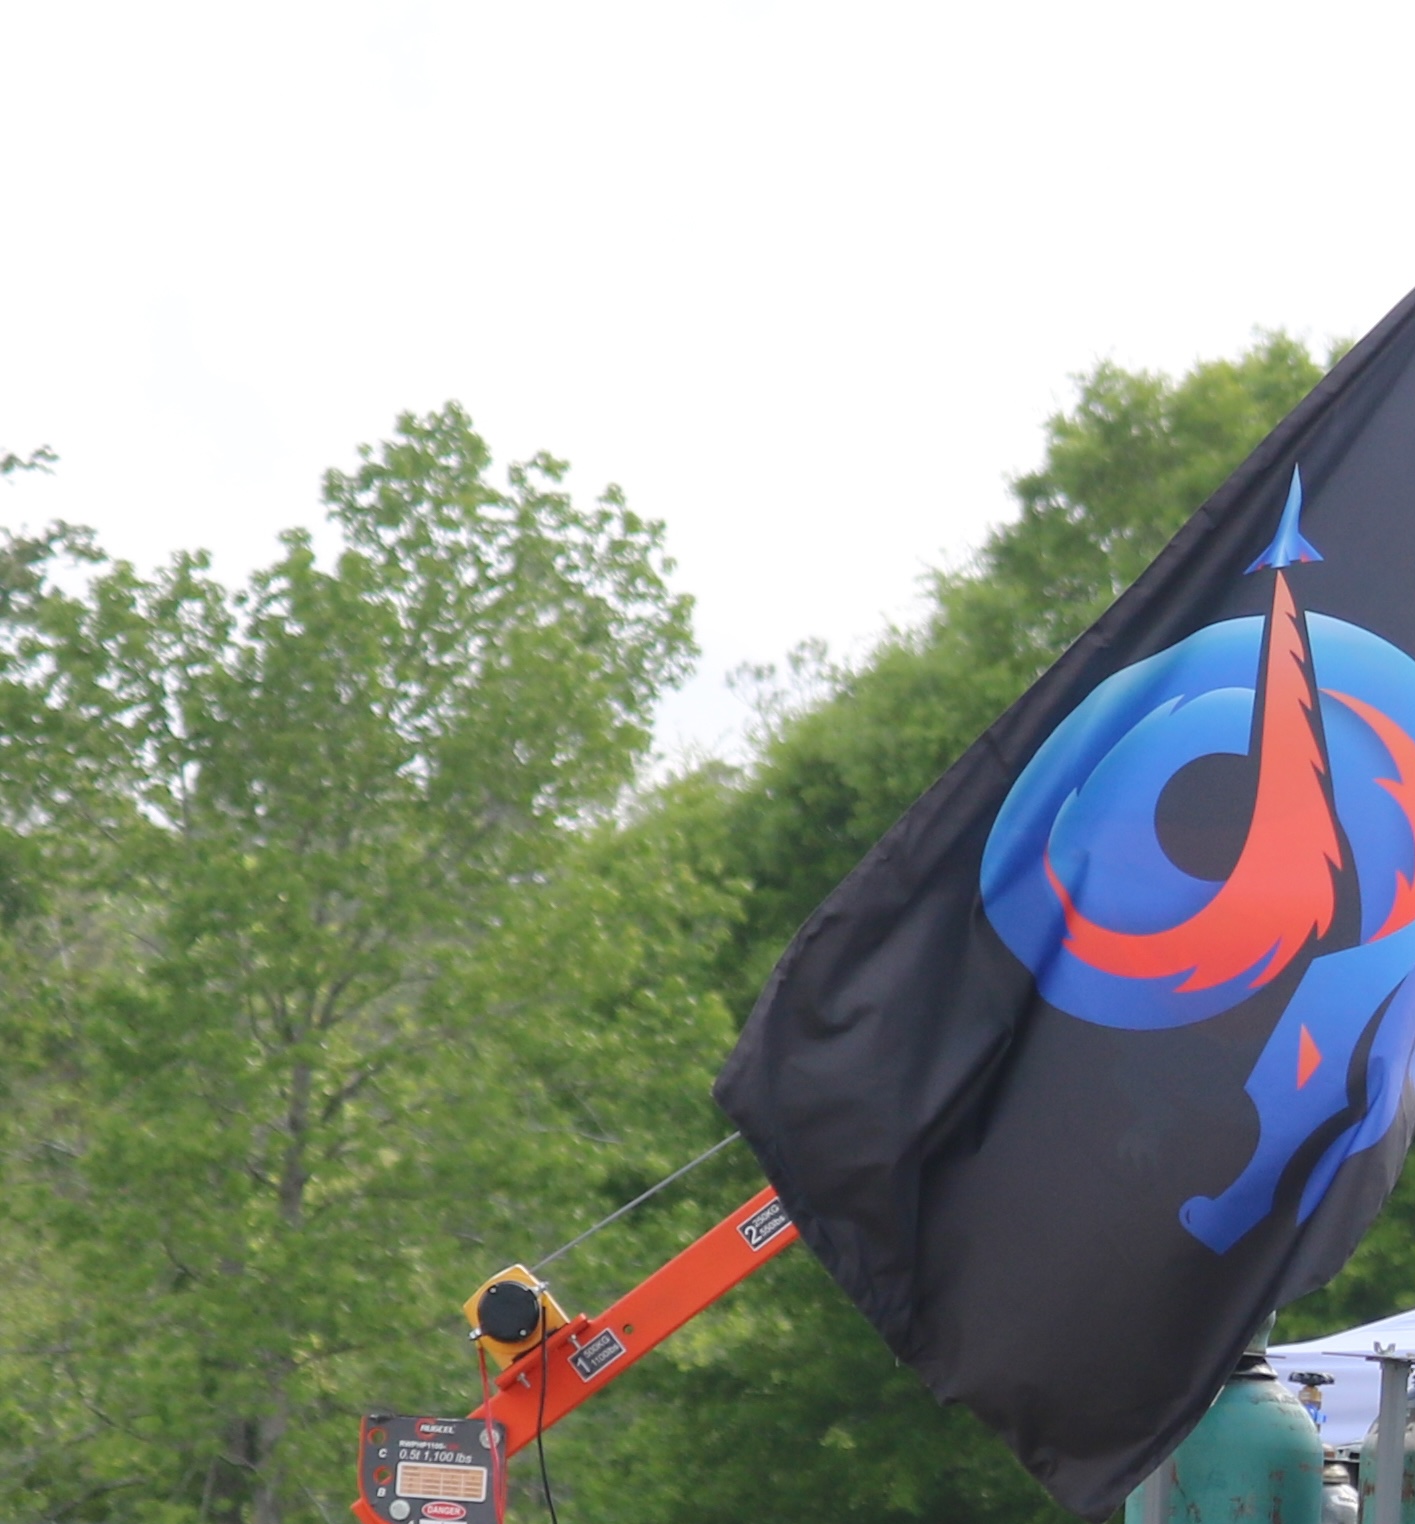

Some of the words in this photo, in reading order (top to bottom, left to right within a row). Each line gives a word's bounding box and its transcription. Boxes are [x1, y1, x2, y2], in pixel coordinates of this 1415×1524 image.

[752, 1204, 780, 1228] 250KG
[744, 1226, 763, 1246] 2
[576, 1357, 591, 1374] 1
[378, 1448, 388, 1459] C
[399, 1448, 420, 1460] 0.5t
[424, 1451, 454, 1462] 1,100
[455, 1452, 473, 1464] lbs
[376, 1487, 387, 1498] B
[427, 1505, 461, 1516] DANGER
